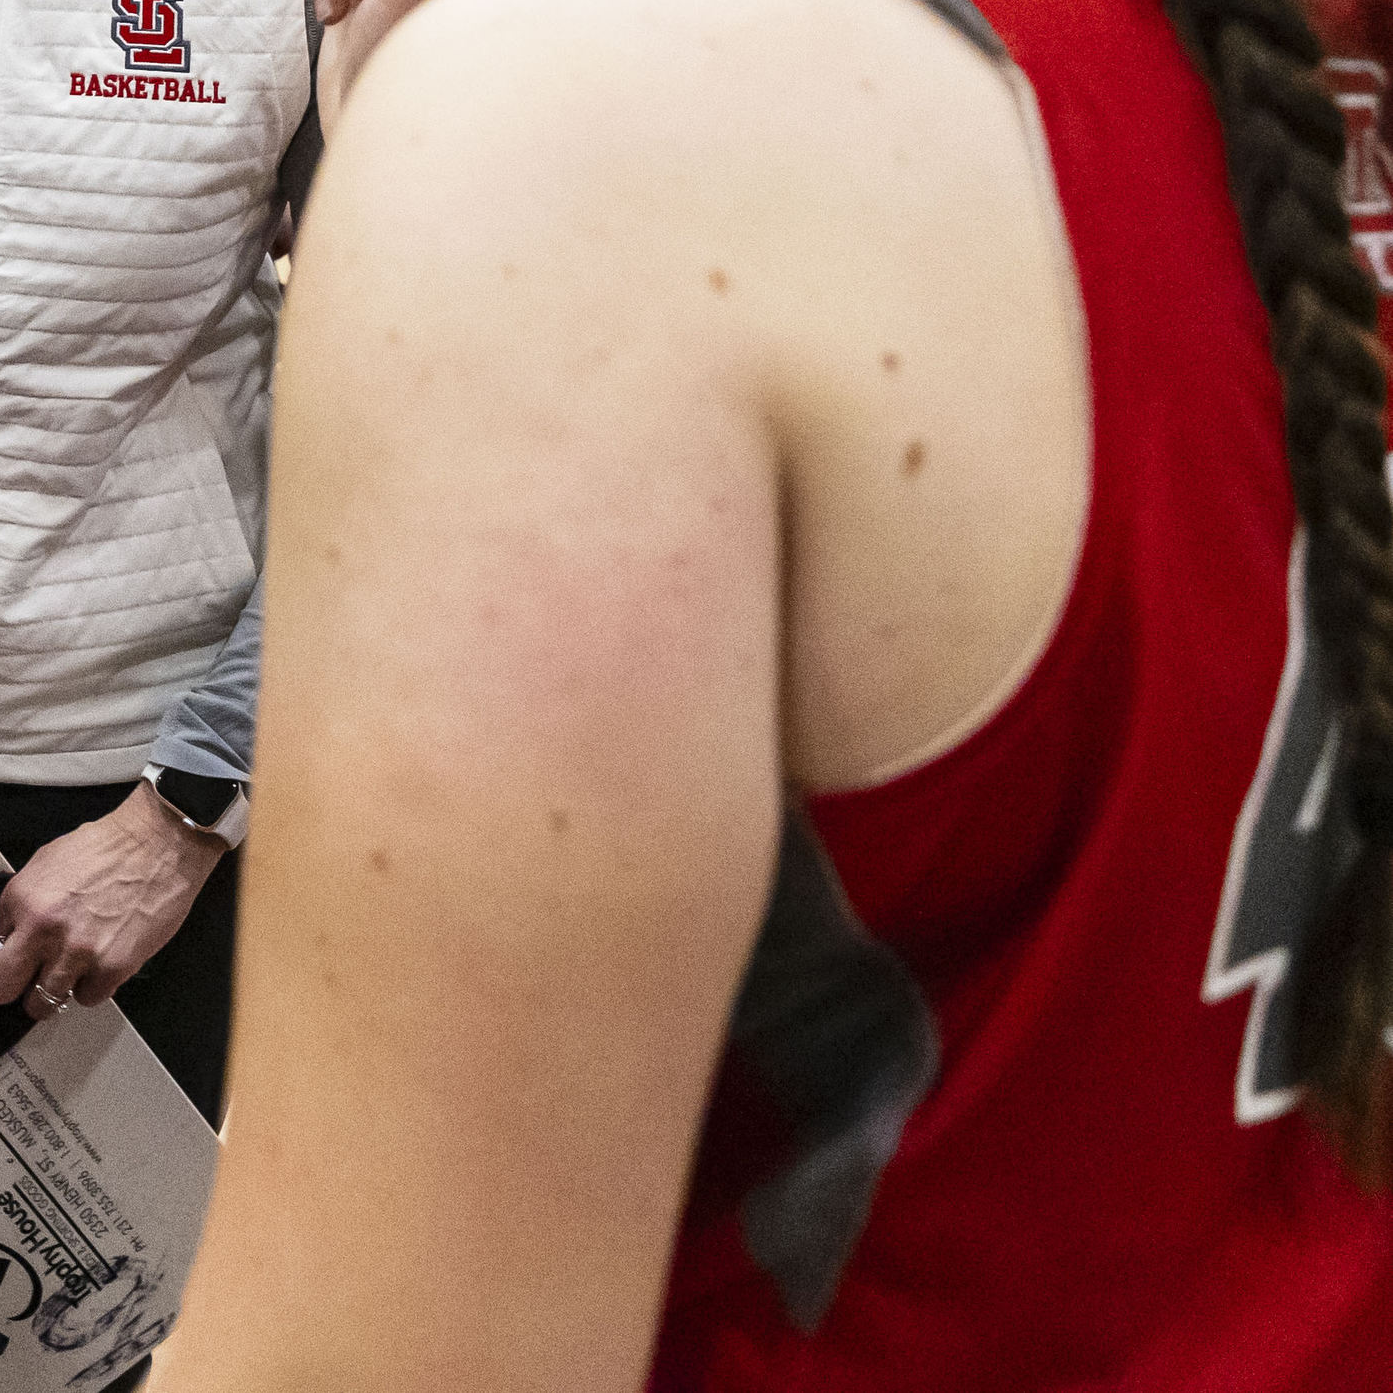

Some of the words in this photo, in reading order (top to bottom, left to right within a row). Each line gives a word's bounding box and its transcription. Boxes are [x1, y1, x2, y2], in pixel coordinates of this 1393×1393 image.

[69, 72, 227, 104] BASKETBALL
[47, 1167, 86, 1211] HENRY
[77, 1205, 109, 1240] 2350
[38, 1243, 91, 1309] Trophy
